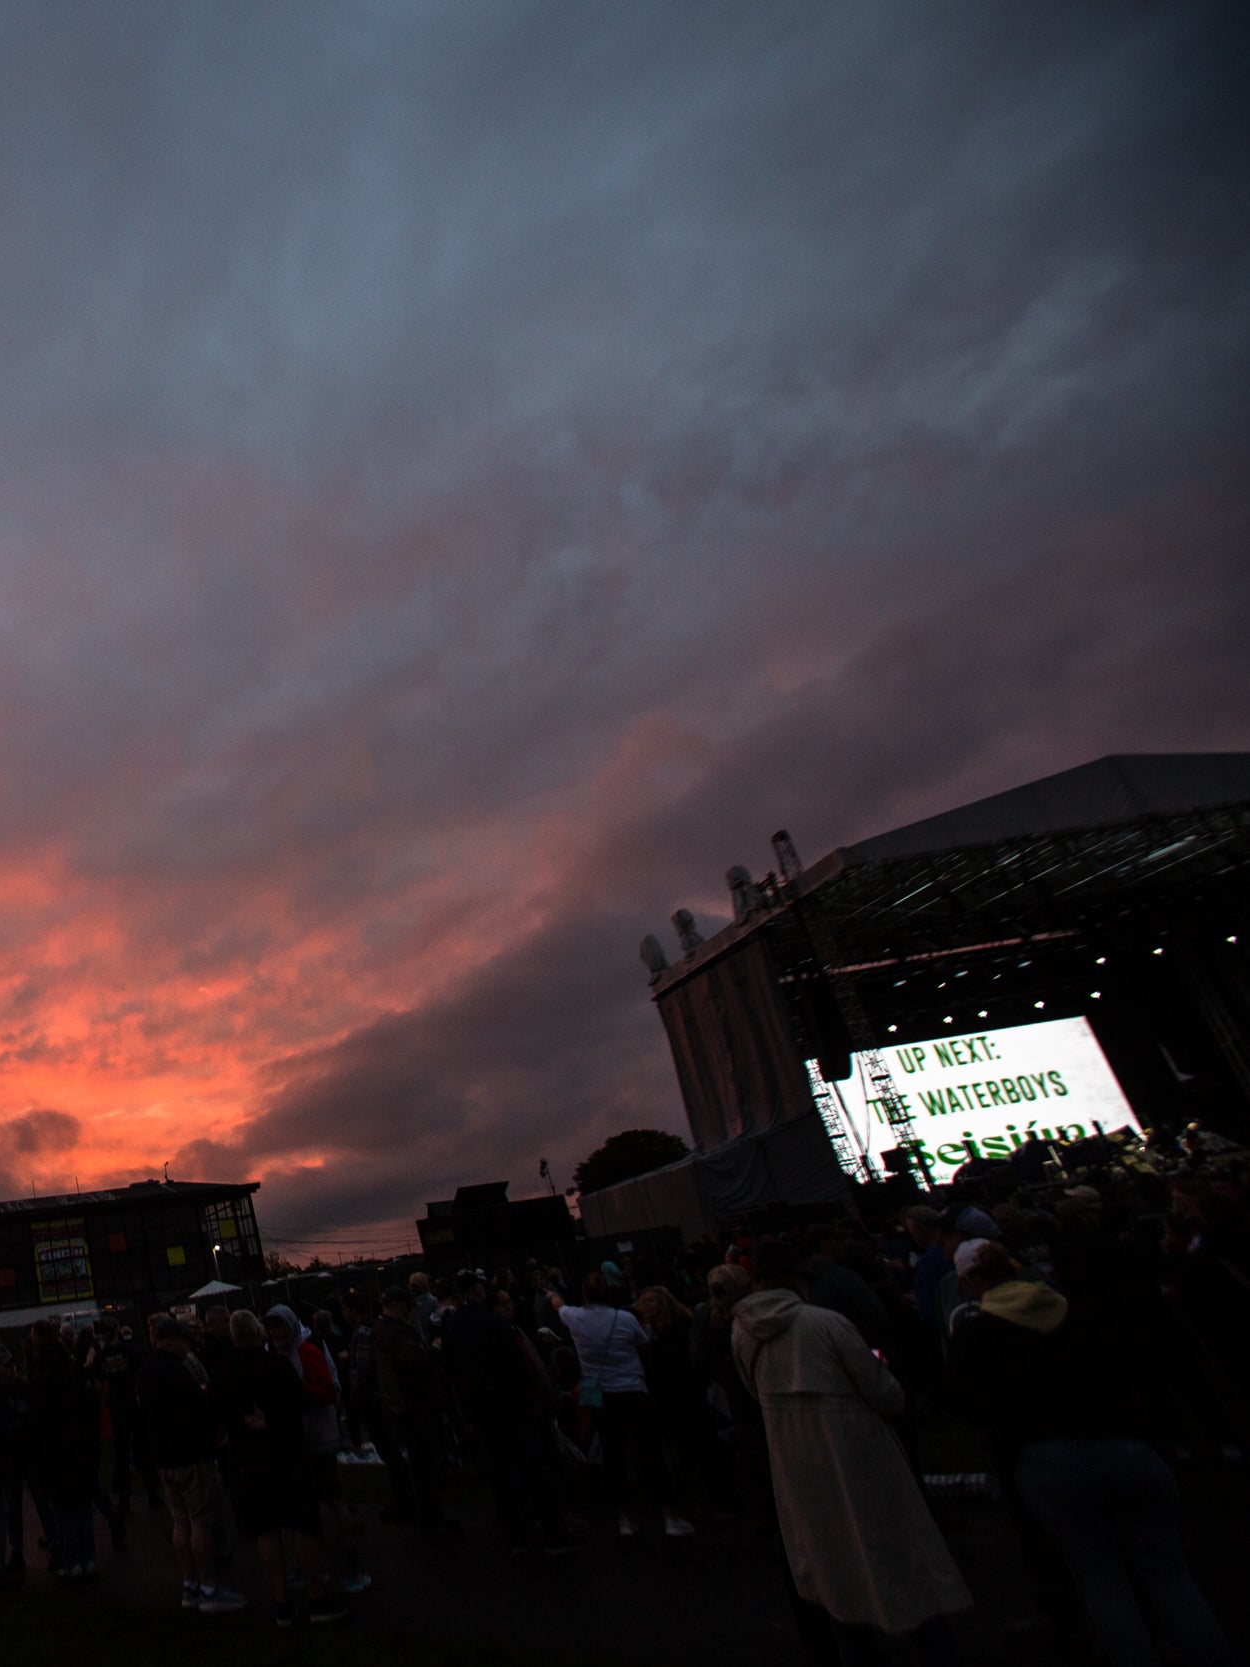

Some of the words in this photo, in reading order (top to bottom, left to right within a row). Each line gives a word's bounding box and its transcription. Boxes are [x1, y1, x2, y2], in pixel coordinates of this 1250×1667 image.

[896, 1047, 926, 1073] UP
[934, 1036, 1001, 1069] NEXT:
[918, 1070, 1069, 1117] WATERBOYS
